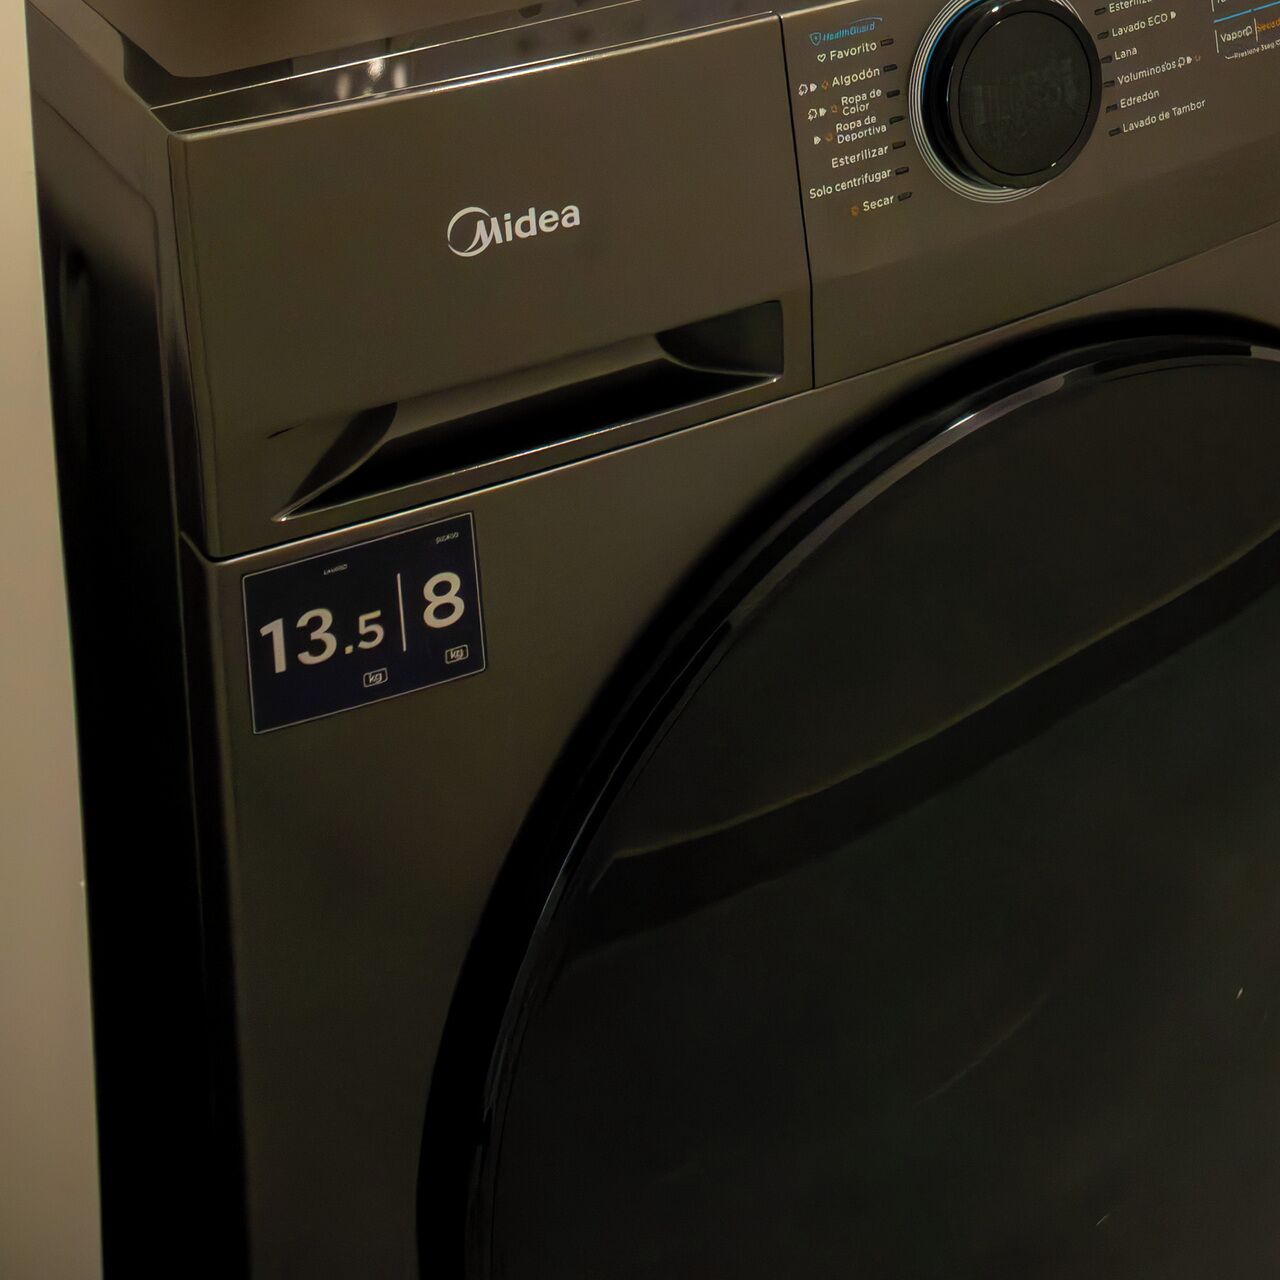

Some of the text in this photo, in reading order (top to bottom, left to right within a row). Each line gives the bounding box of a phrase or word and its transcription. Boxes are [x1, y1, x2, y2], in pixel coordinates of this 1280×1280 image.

[1112, 13, 1168, 37] Lavado ECO
[1220, 28, 1247, 42] Vapor
[830, 42, 877, 60] Favorito
[1114, 47, 1138, 60] Lana
[832, 68, 880, 88] Algodón
[841, 88, 882, 106] Ropa de
[1120, 90, 1160, 109] Edredón
[842, 102, 870, 116] Color
[1122, 99, 1206, 133] Lavado de Tambor
[835, 115, 877, 133] Ropa de
[837, 124, 887, 144] Deportiva
[831, 145, 889, 168] Esterilizar
[809, 169, 892, 199] Solo centrifugar
[863, 195, 895, 211] Secar
[447, 205, 581, 257] Midea
[422, 571, 465, 629] 8
[259, 608, 385, 674] 13.5
[367, 671, 382, 684] kg
